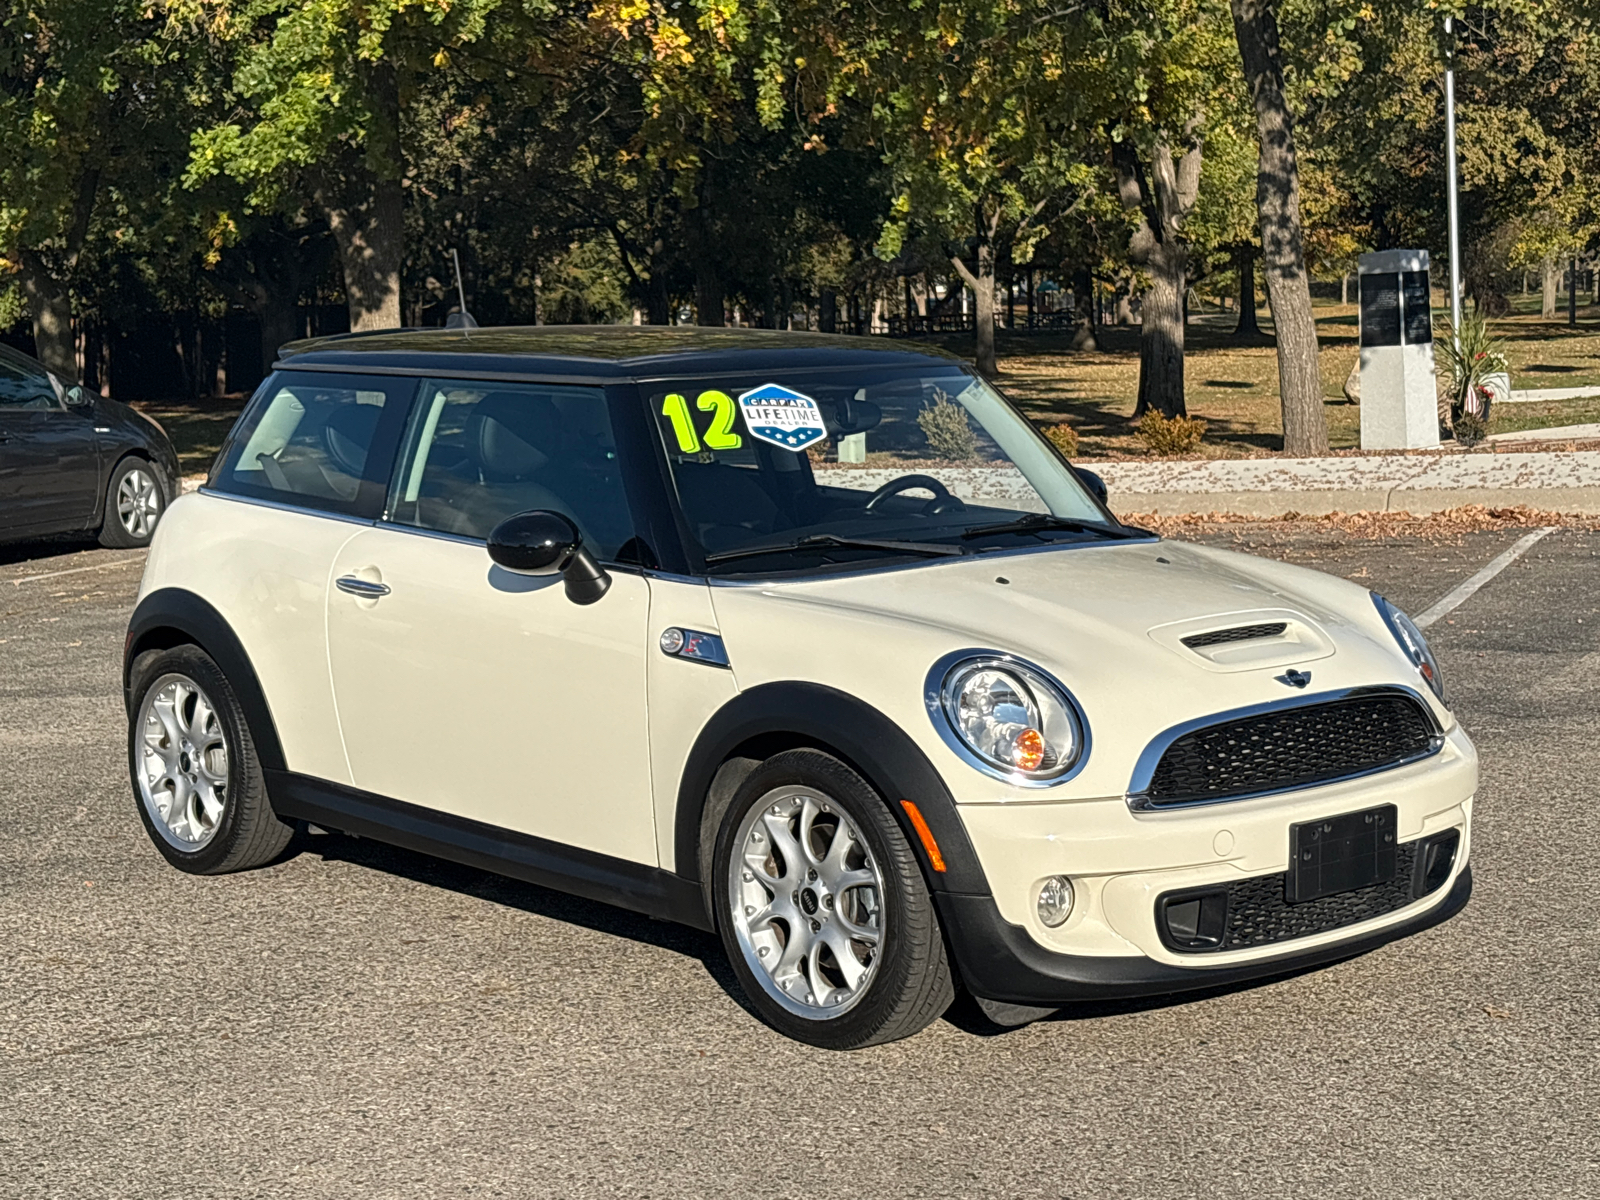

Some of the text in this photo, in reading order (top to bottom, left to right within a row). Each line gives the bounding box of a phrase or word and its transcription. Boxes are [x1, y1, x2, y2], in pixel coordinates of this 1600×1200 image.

[749, 398, 808, 408] CARFAX
[662, 390, 742, 453] 12
[745, 408, 820, 421] LIFETIME
[802, 891, 816, 912] MINI
